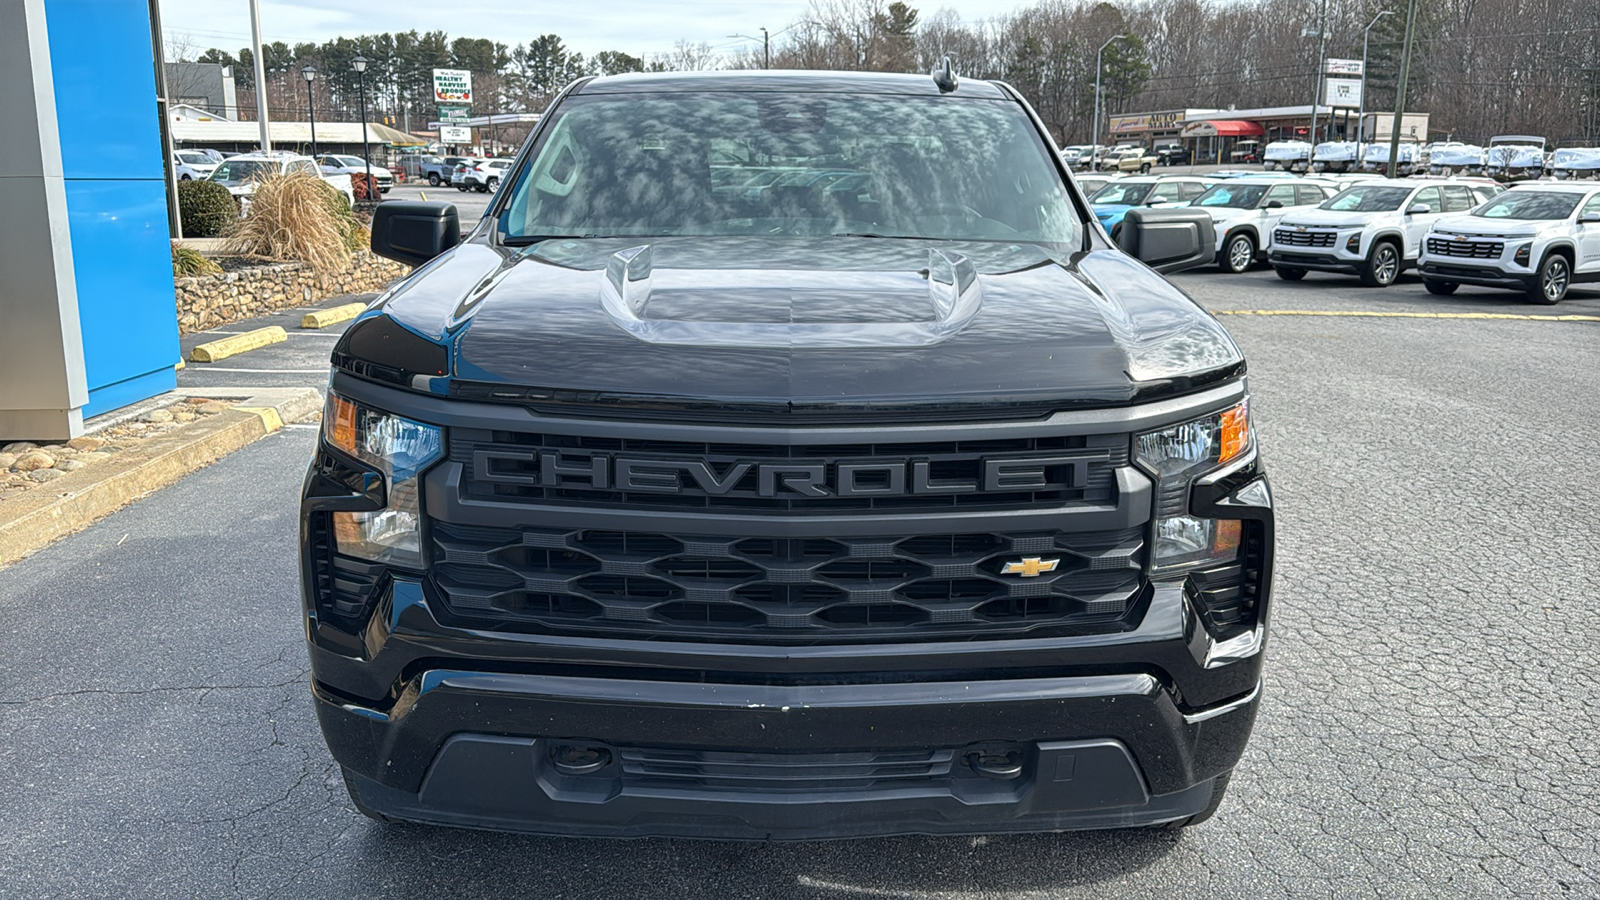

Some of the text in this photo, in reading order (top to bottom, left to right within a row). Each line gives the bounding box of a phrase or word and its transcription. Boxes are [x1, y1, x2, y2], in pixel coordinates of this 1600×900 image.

[1150, 113, 1176, 121] AUTO
[1148, 121, 1176, 129] MART
[473, 449, 1111, 497] CHEVROLET
